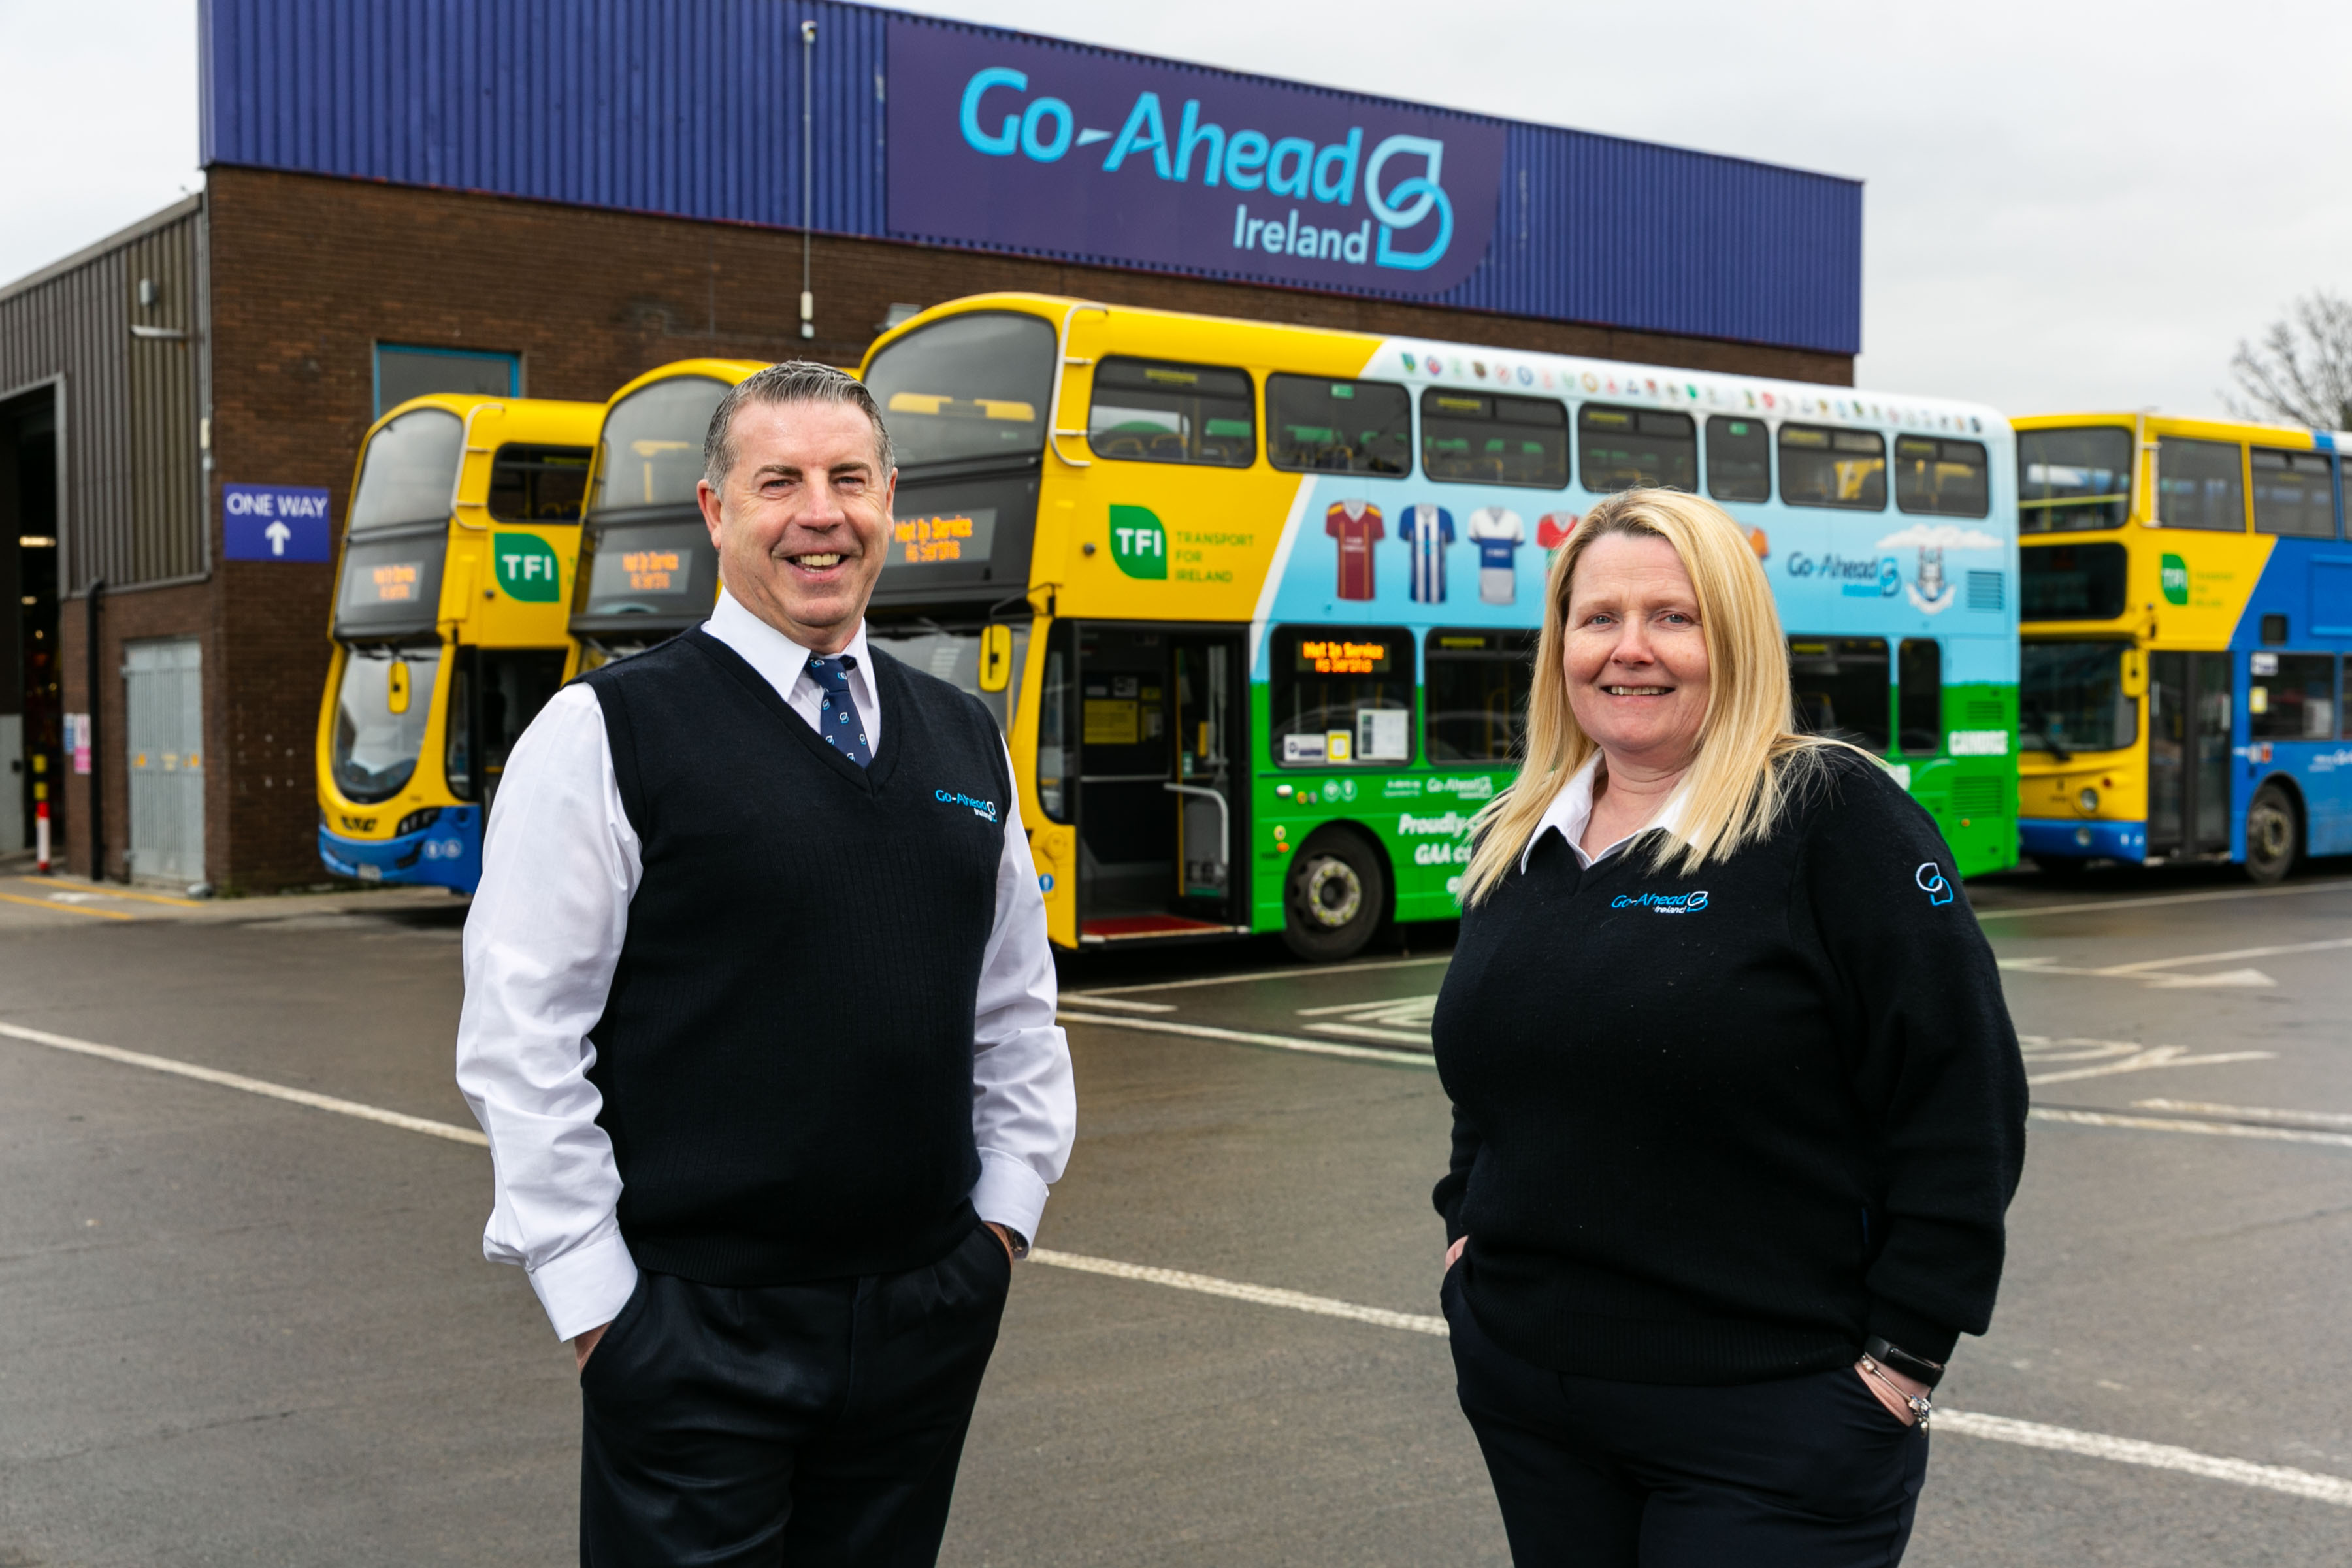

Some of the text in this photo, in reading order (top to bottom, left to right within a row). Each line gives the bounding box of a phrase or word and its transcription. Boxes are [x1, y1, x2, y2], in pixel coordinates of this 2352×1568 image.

[958, 66, 1364, 206] Go-Ahead
[1233, 204, 1369, 265] Ireland
[226, 492, 328, 518] ONE WAY
[931, 515, 973, 540] Service
[1176, 530, 1254, 547] TRANSPORT
[1115, 527, 1162, 557] TFI
[501, 554, 553, 581] TFI
[1175, 549, 1203, 563] FOR
[1175, 568, 1233, 584] IRELAND
[1303, 641, 1327, 659] Not
[1343, 641, 1384, 661] Service
[935, 789, 988, 811] Go-Ahead
[1398, 811, 1467, 839] Proudly
[1414, 843, 1452, 866] GAA
[1611, 892, 1691, 909] Go-Ahead
[1654, 905, 1687, 914] Ireland
